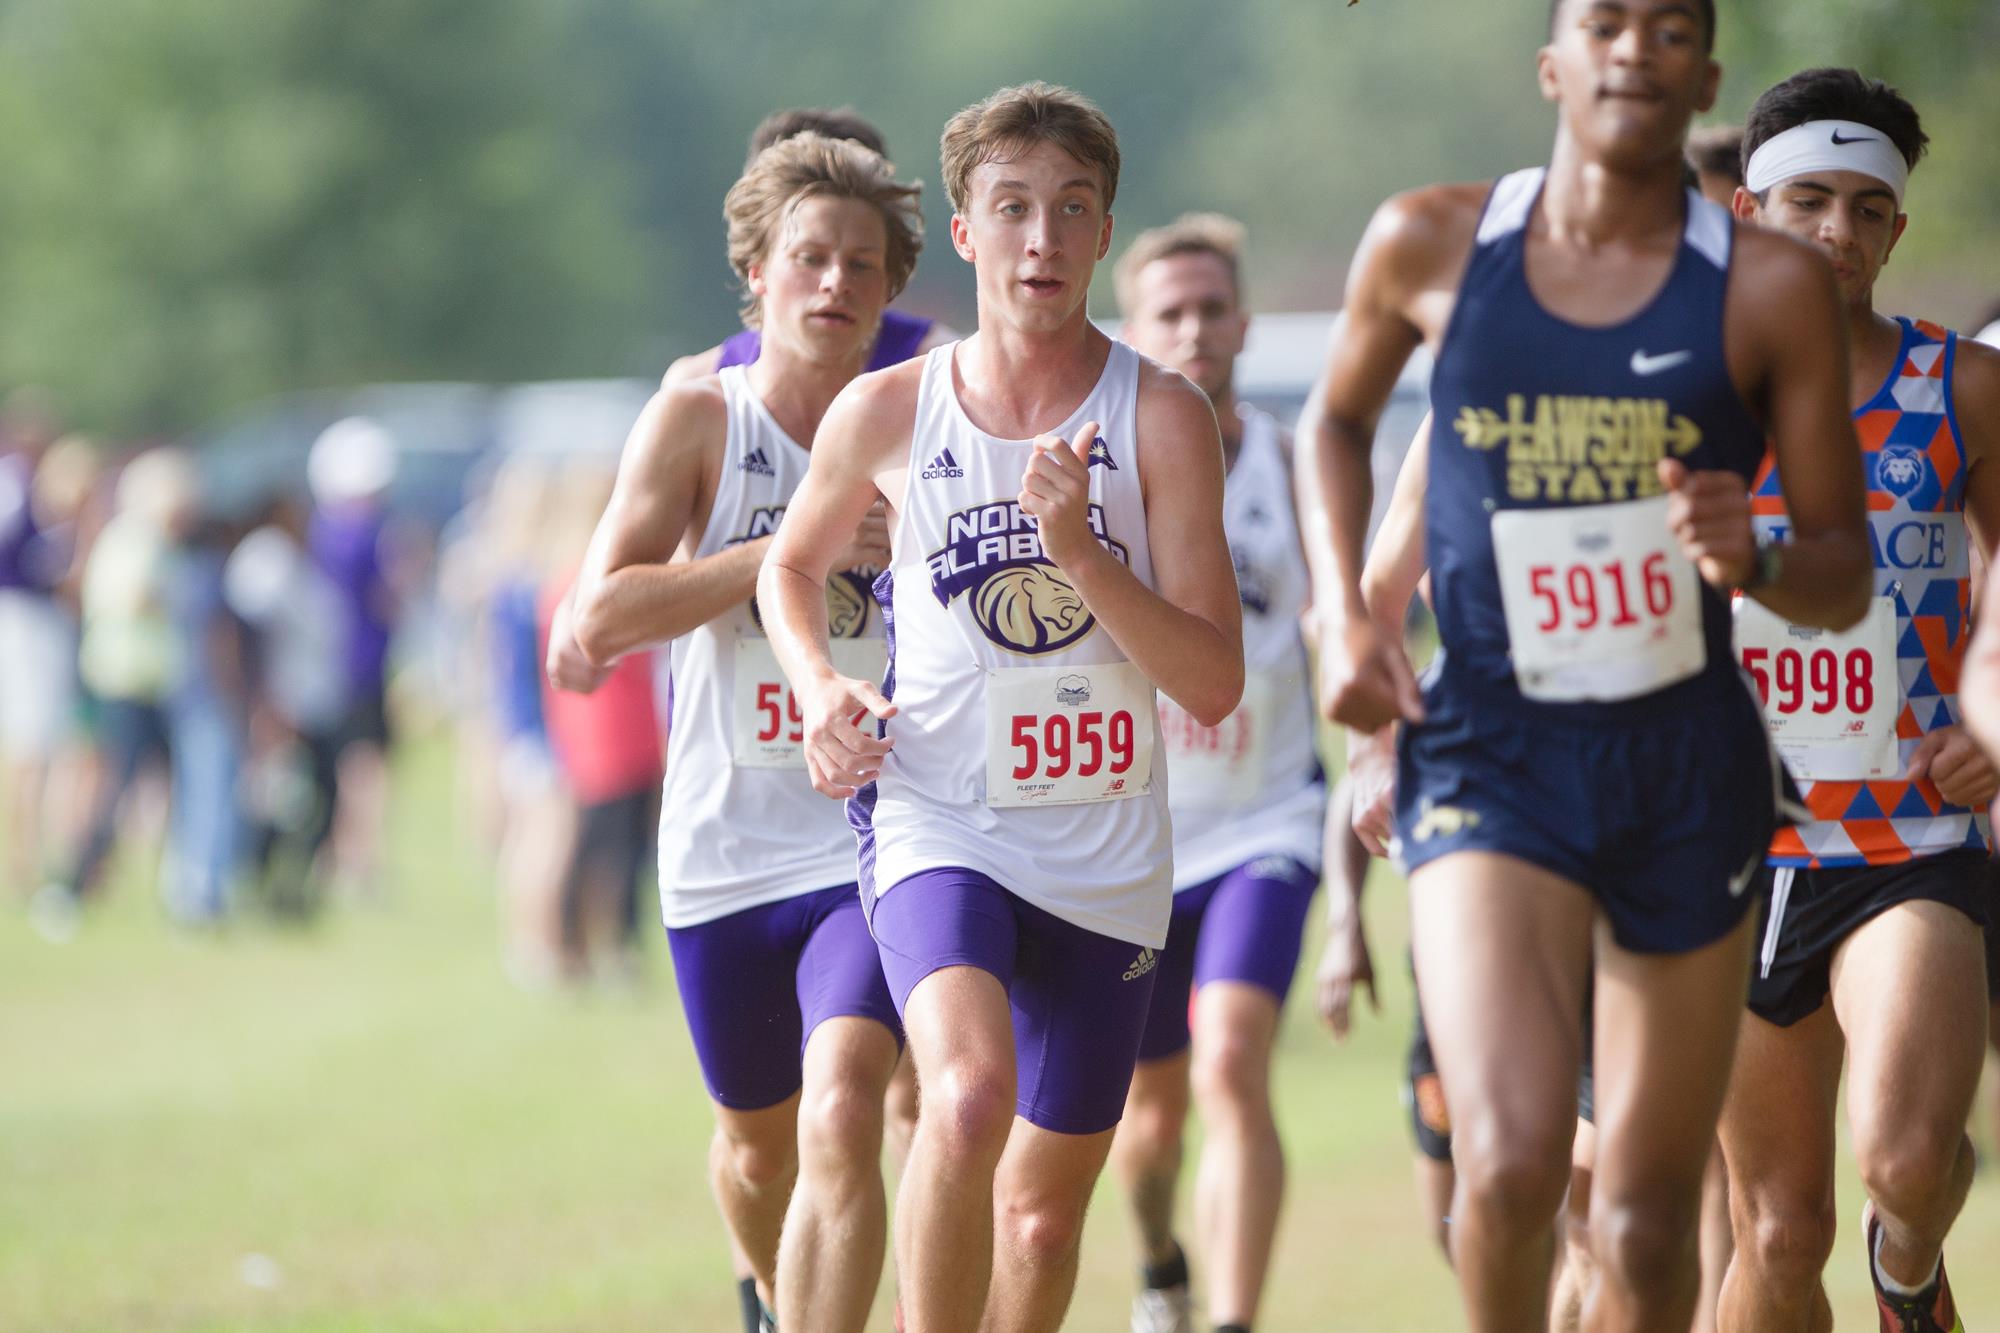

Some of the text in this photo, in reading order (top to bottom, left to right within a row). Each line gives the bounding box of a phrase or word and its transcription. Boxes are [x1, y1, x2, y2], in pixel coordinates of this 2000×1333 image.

[1506, 394, 1669, 464] LAWSON
[921, 466, 964, 480] adidas
[950, 502, 1105, 545] NORH
[1529, 551, 1674, 633] 5916
[1742, 647, 1874, 715] 5998
[1011, 709, 1134, 780] 5959
